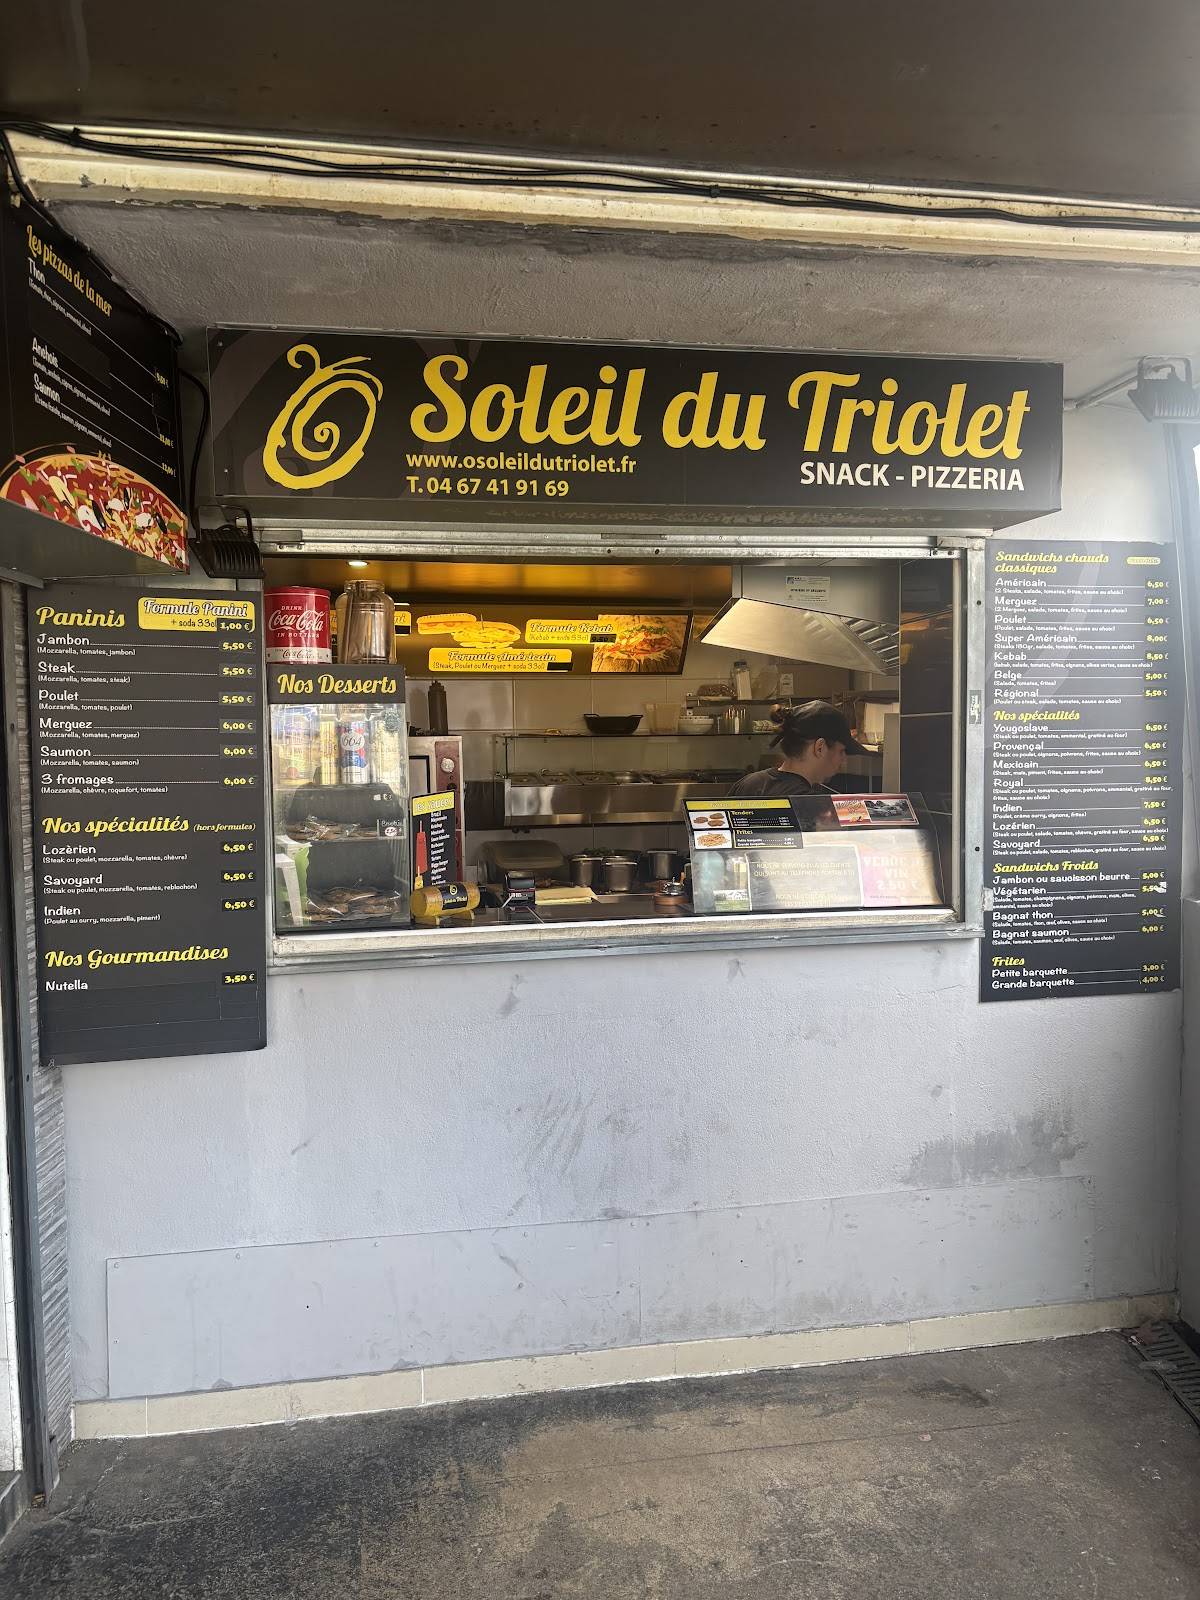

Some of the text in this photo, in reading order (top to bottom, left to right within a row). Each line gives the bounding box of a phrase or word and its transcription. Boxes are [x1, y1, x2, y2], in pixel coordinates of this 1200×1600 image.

[27, 225, 112, 316] Les pizzas de la mer
[28, 257, 45, 284] Thon
[34, 373, 60, 403] Saumon
[410, 355, 1030, 459] Soleil du Triolet
[406, 452, 636, 473] www.osoleildutriolet.fr
[800, 462, 889, 486] SNACK
[912, 466, 1024, 490] PIZZERIA
[427, 477, 451, 494] 04
[457, 478, 481, 494] 67
[486, 479, 508, 495] 41
[516, 480, 538, 496] 91
[545, 481, 569, 496] 69
[995, 551, 1109, 563] Sandwichs chauds
[994, 563, 1057, 575] classiques
[995, 578, 1046, 587] Américain
[994, 596, 1037, 606] Merguez
[144, 601, 247, 617] Formule Panini
[36, 606, 126, 628] Paninis
[268, 610, 325, 632] Coca-Cola
[994, 615, 1026, 624] Poulet
[178, 619, 195, 627] soda
[220, 622, 242, 630] 1,00
[530, 623, 613, 633] Formule Kebab
[37, 634, 90, 645] Jambon
[994, 634, 1078, 646] Super Américain
[223, 642, 244, 650] 5,50
[37, 647, 79, 656] (Mozzarella,
[80, 648, 108, 656] tomates,
[994, 652, 1027, 661] Kebab
[38, 662, 75, 673] Steak
[223, 667, 244, 675] 5,50
[38, 675, 80, 683] (Mozzarella,
[994, 671, 1022, 680] Belge
[278, 674, 397, 694] Nos Desserts
[39, 690, 79, 701] Poulet
[994, 689, 1039, 698] Régional
[222, 696, 244, 704] 5,50
[39, 703, 80, 711] (Mozzarella,
[111, 704, 132, 712] poulet)
[993, 710, 1080, 722] Nos spécialités
[40, 718, 92, 730] Merguez
[223, 723, 245, 731] 6,00
[993, 724, 1049, 734] Yougoslave
[40, 731, 81, 739] (Mozzarella,
[41, 746, 91, 757] Saumon
[993, 742, 1044, 751] Provençal
[224, 748, 246, 756] 6,00
[993, 760, 1039, 769] Mexicain
[41, 774, 114, 786] 3 fromages
[224, 777, 246, 786] 6,00
[993, 778, 1023, 788] Royal
[41, 786, 82, 794] (Mozzarella,
[108, 787, 139, 795] roquefort,
[993, 804, 1022, 812] Indien
[42, 817, 81, 833] Nos
[85, 816, 189, 837] spécialités
[993, 822, 1035, 830] Lozérien
[224, 843, 245, 852] 6,50
[993, 839, 1040, 850] Savoyard
[43, 856, 65, 864] (Steak
[76, 856, 98, 864] poulet,
[993, 861, 1099, 873] Sandwichs Froids
[44, 874, 102, 887] Savoyard
[224, 872, 245, 880] 6,50
[993, 876, 1034, 885] Jambon
[1099, 873, 1130, 881] beurre
[77, 886, 98, 894] poulet,
[99, 885, 135, 893] mozzarella,
[164, 883, 197, 891] reblochon)
[993, 887, 1046, 897] Végétarien
[225, 901, 247, 909] 6,50
[44, 906, 81, 916] Indien
[44, 917, 68, 925] (Poulet
[137, 915, 161, 923] piment)
[993, 911, 1053, 922] Bagnat thon
[993, 929, 1069, 940] Bagnat saumon
[45, 946, 229, 969] Nos Gourmandises
[992, 957, 1024, 967] Frites
[225, 974, 247, 983] 3,50
[992, 968, 1067, 979] Petite barquette
[46, 980, 88, 991] Nutella
[992, 978, 1075, 990] Grande barquette
